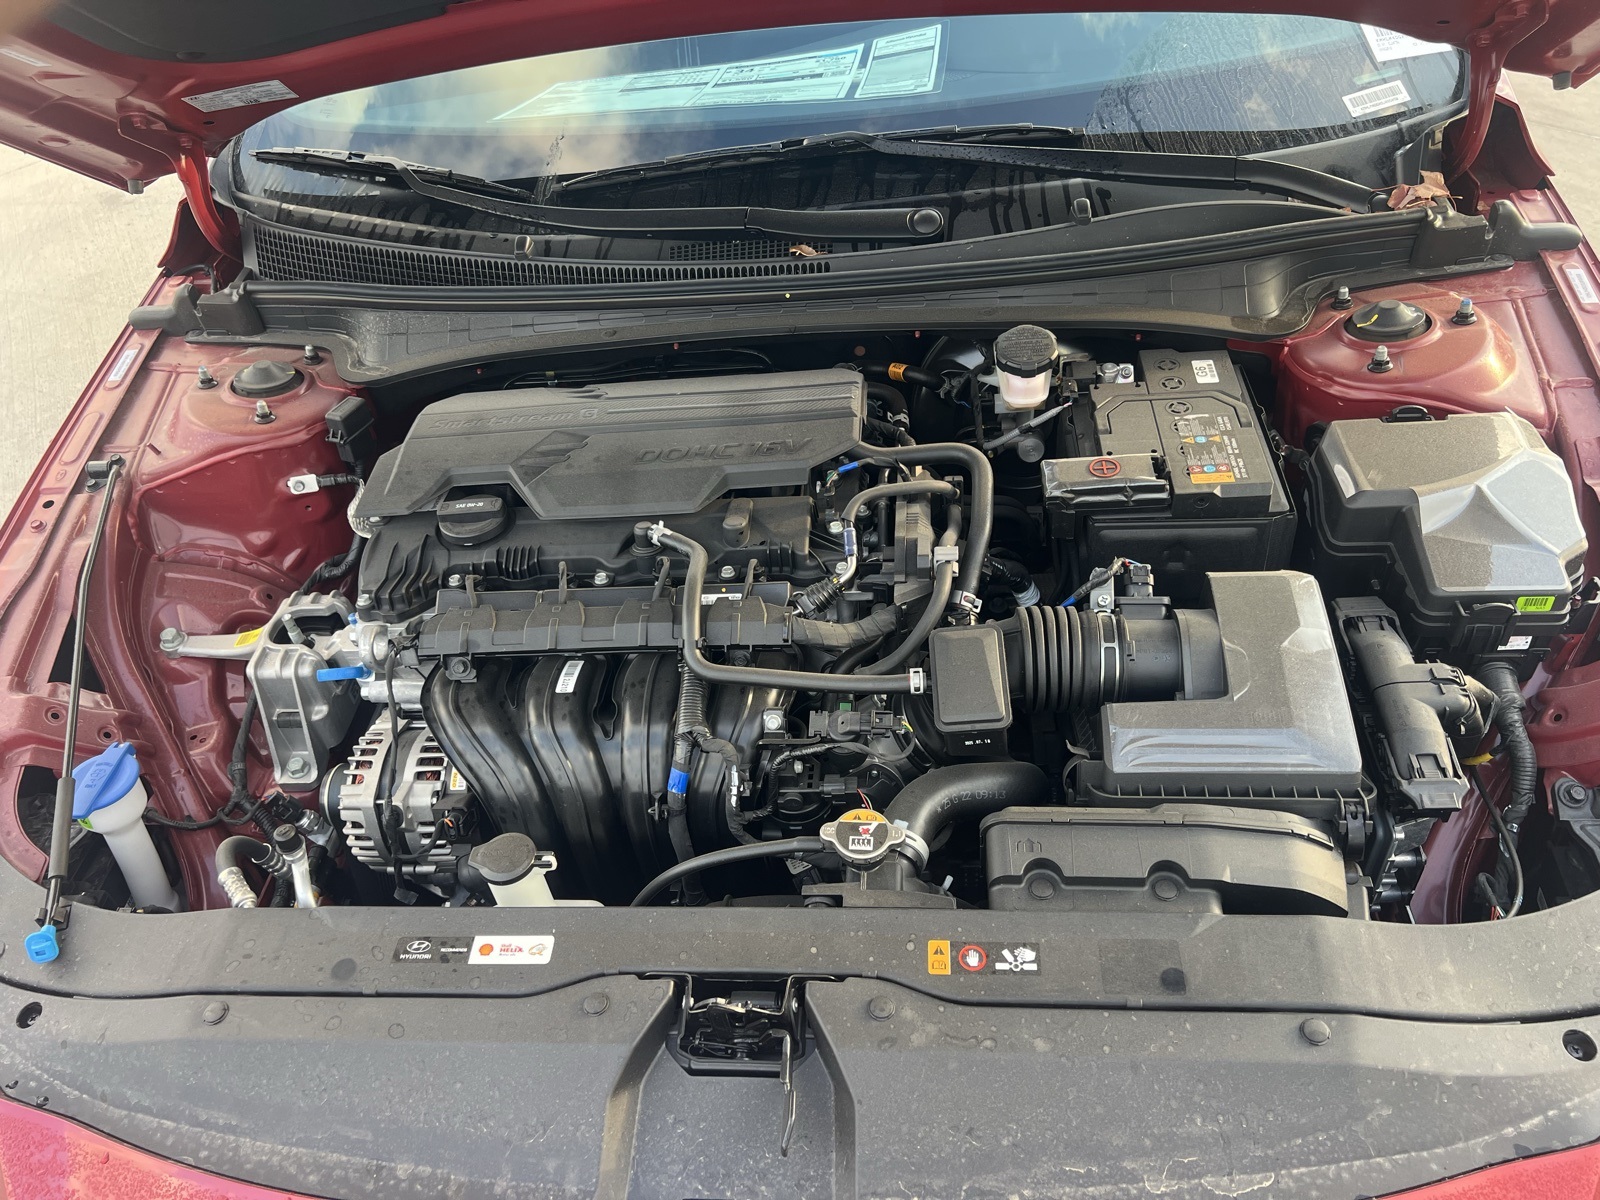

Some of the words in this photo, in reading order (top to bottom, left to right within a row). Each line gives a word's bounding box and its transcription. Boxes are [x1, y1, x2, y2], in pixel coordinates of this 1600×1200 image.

[1195, 366, 1208, 378] G6
[429, 412, 575, 430] Smartstream
[633, 442, 743, 465] DOHC
[748, 437, 814, 458] 16V
[952, 793, 959, 804] G
[960, 790, 972, 802] 22
[975, 789, 1007, 800] 09:13
